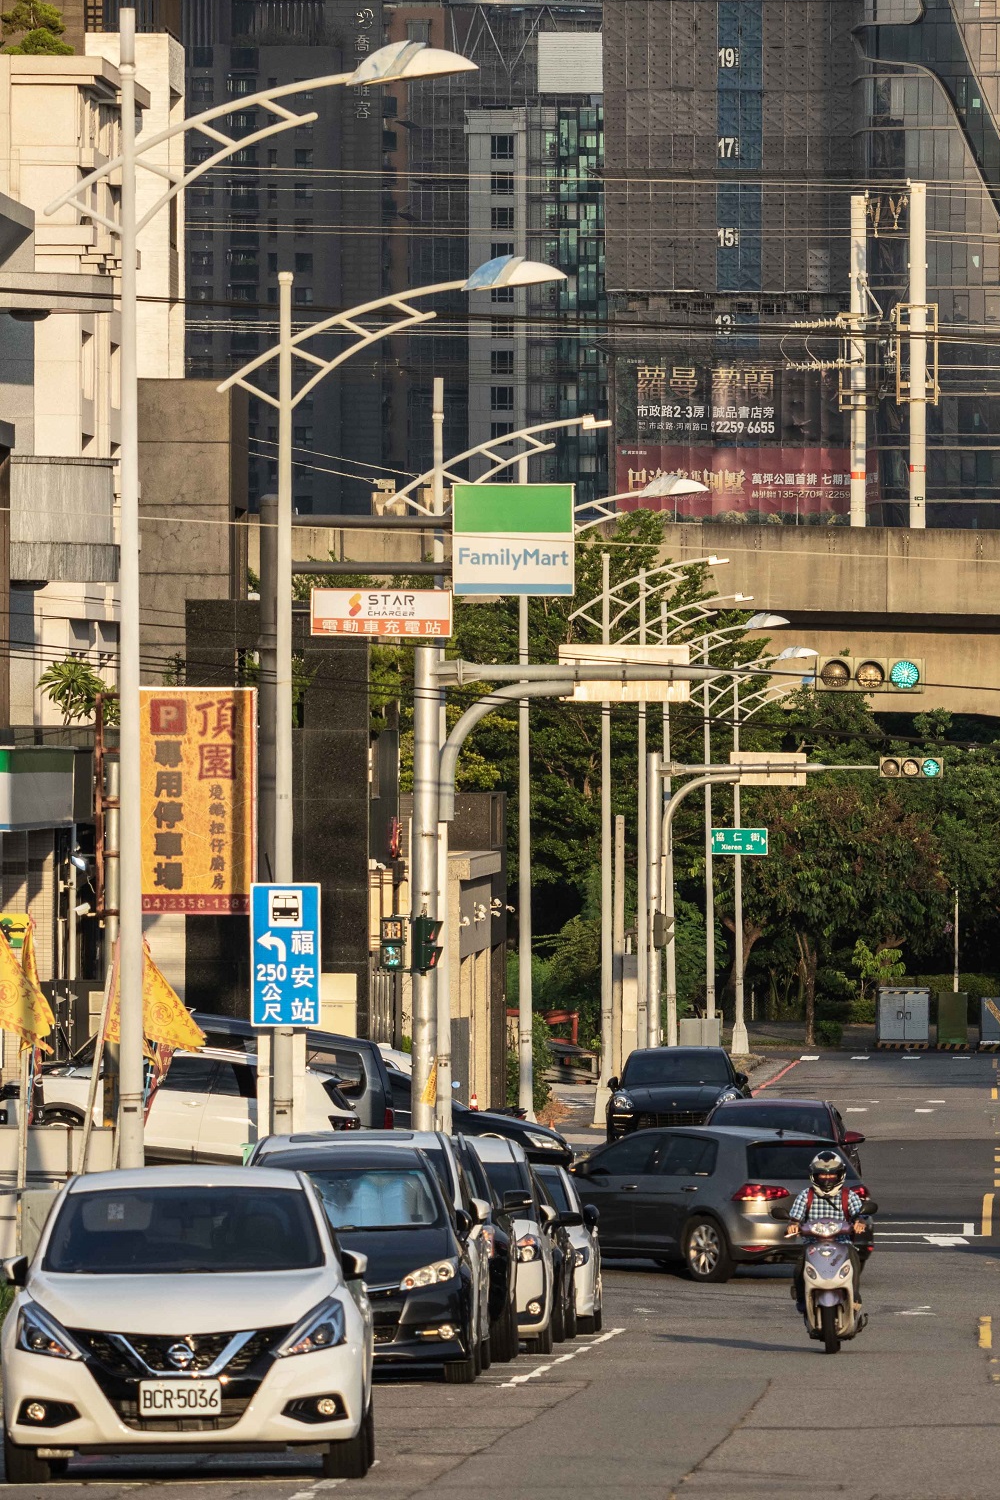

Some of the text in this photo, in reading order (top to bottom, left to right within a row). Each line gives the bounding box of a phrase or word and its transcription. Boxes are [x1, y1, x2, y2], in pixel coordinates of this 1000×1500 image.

[718, 48, 735, 68] 19
[718, 137, 735, 158] 17
[718, 228, 734, 248] 15
[458, 547, 569, 571] FamilyMart
[368, 594, 415, 606] STAR
[321, 619, 442, 635] 電動車充電站
[195, 697, 237, 781] 頂園
[256, 963, 287, 982] 250
[290, 930, 316, 1022] 福安站
[260, 983, 283, 1022] 公尺
[143, 1388, 218, 1409] BCR-5036
